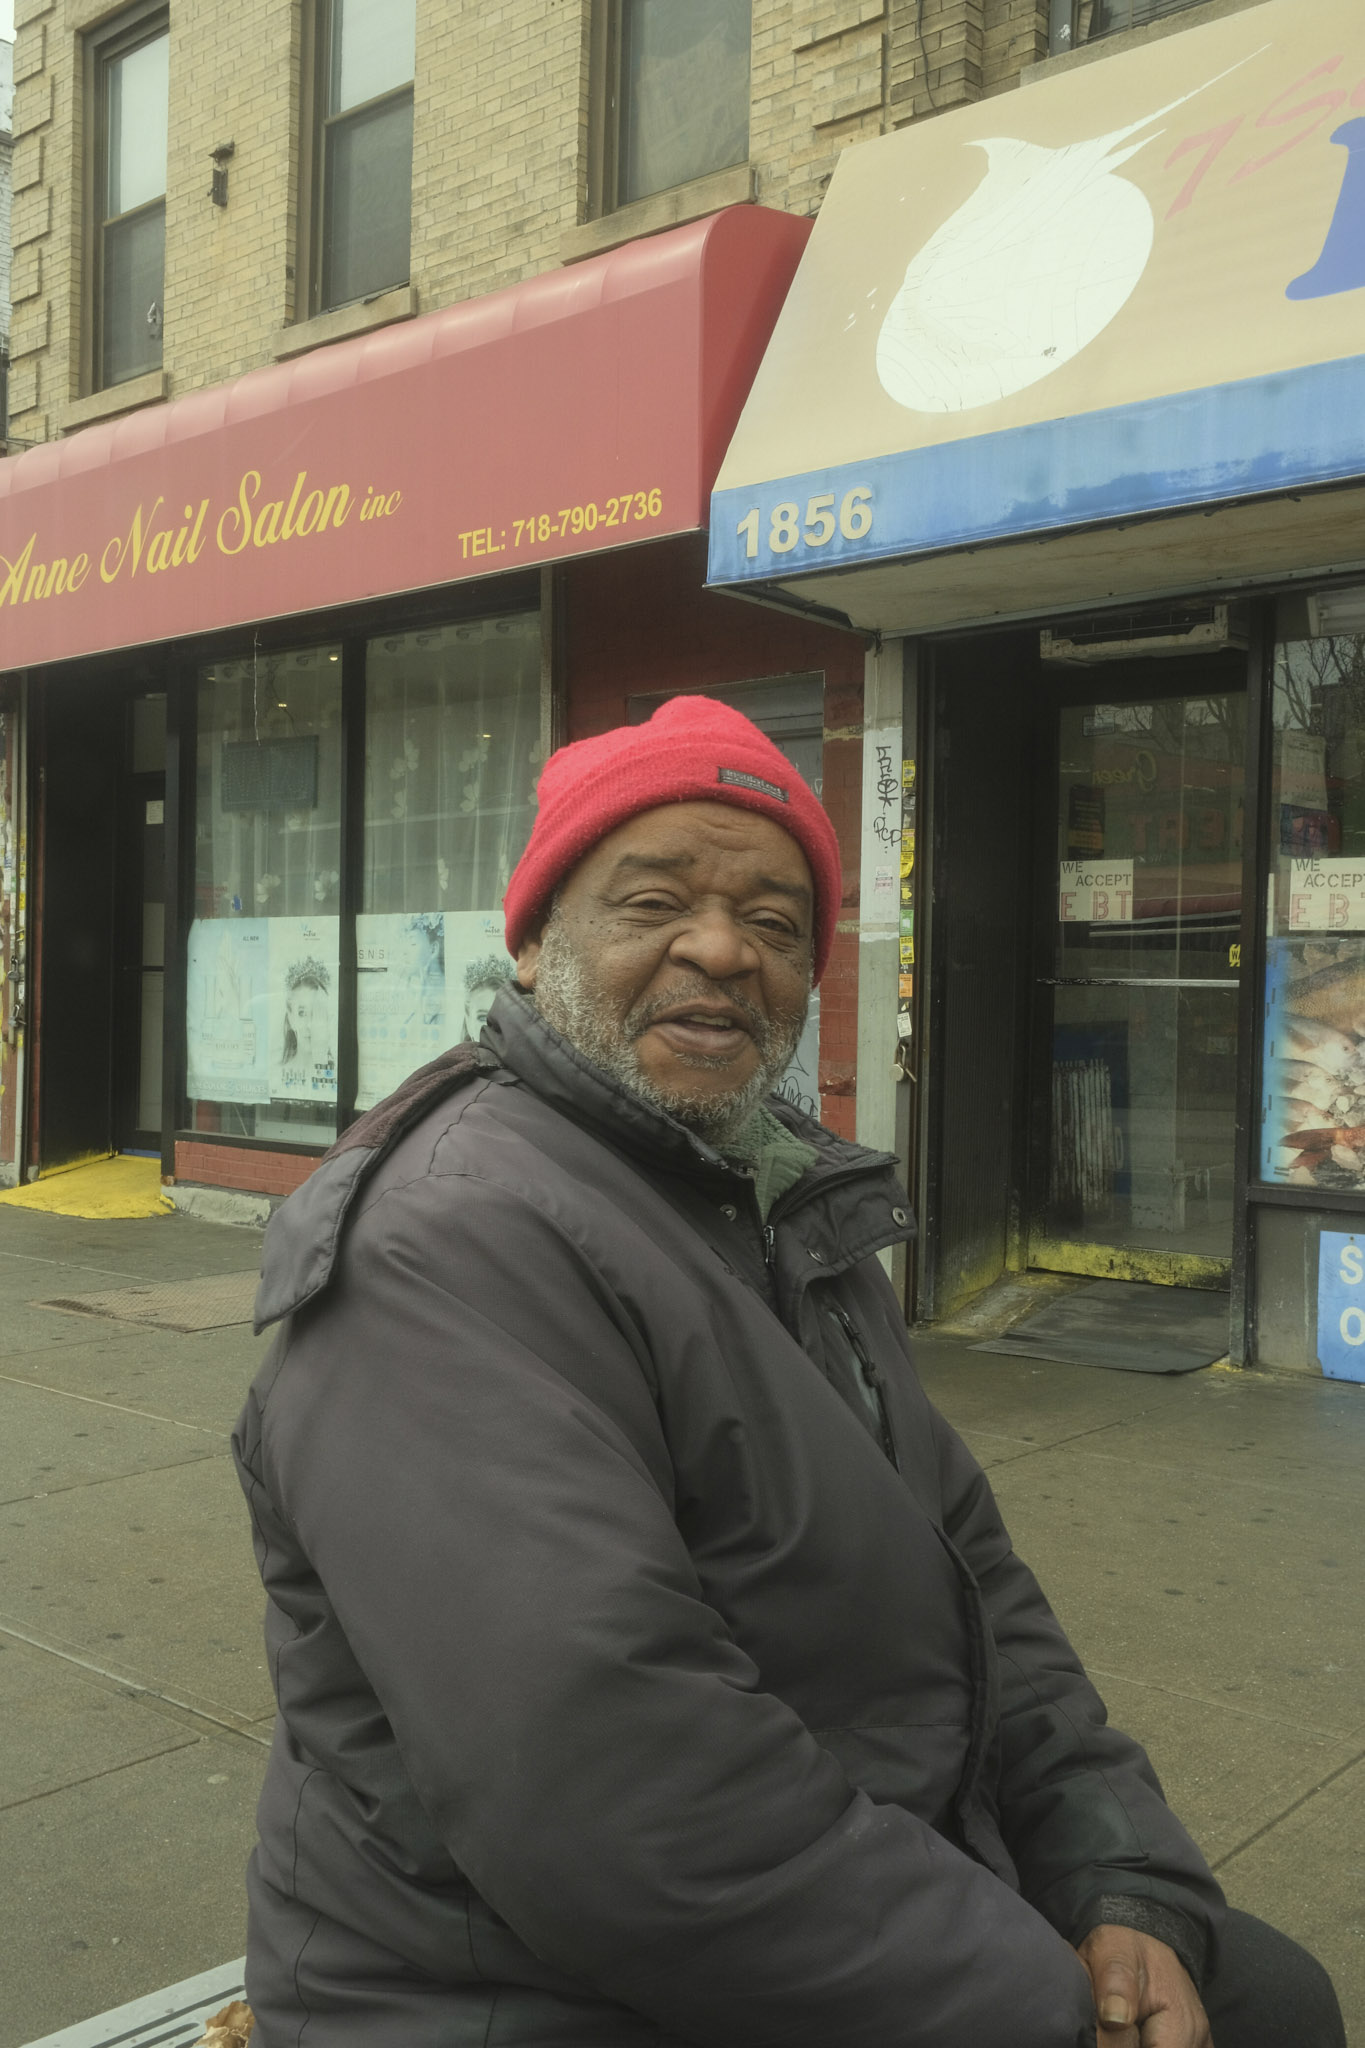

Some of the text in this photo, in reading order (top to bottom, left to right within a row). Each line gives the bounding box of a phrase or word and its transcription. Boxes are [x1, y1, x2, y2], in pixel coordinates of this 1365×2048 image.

[458, 487, 663, 559] TEL: 718-790-2736
[736, 486, 873, 558] 1856
[0, 470, 403, 608] Anne Nail Salon inc
[1062, 861, 1084, 874] WE
[1295, 857, 1320, 872] WE
[1076, 873, 1132, 887] ACCEPT
[1303, 873, 1365, 888] ACCEP
